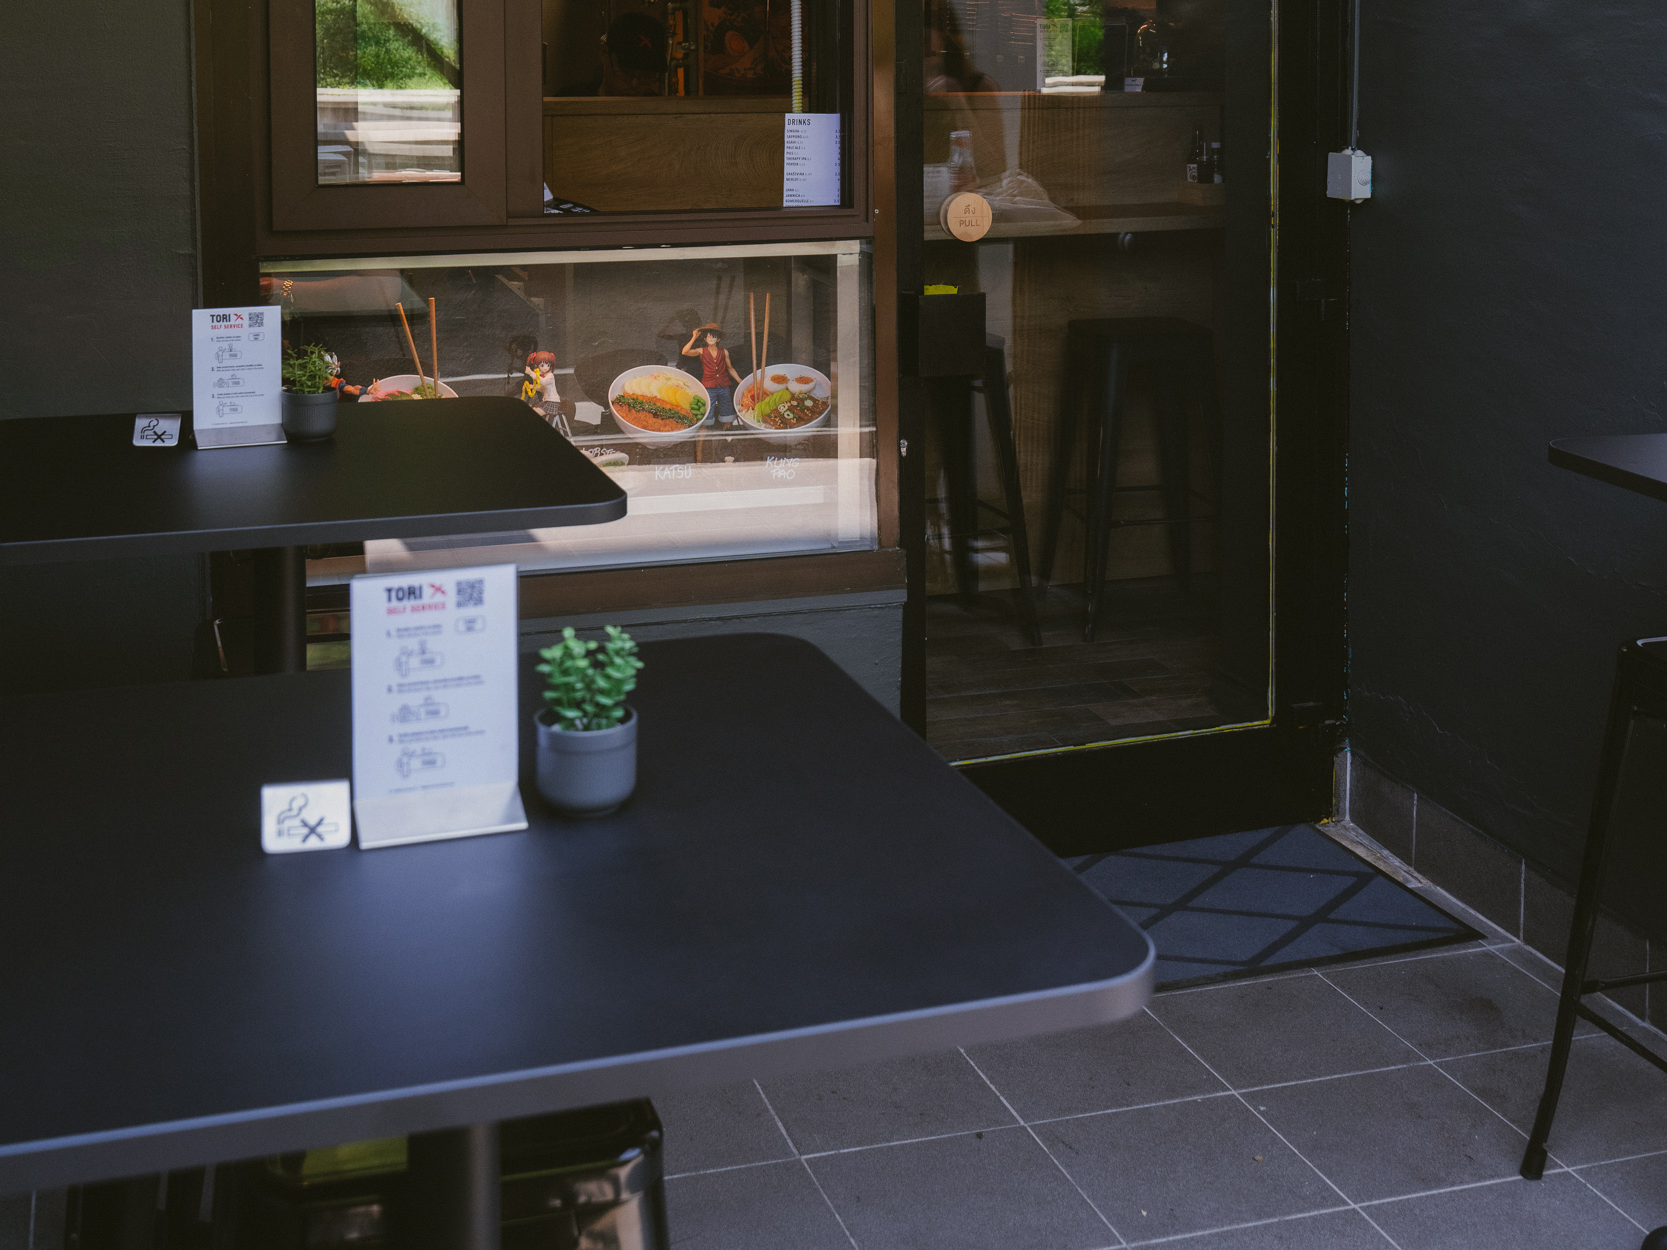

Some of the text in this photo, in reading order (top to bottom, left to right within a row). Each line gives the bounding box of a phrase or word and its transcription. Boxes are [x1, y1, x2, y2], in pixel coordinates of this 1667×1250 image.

[787, 118, 811, 126] DRINKS
[959, 219, 980, 227] PULL
[210, 313, 231, 323] TORI
[765, 456, 800, 469] KUNG
[655, 464, 692, 480] KATSU
[771, 468, 796, 480] PAO
[384, 584, 423, 603] TORI
[386, 602, 447, 615] SELF SERVICE
